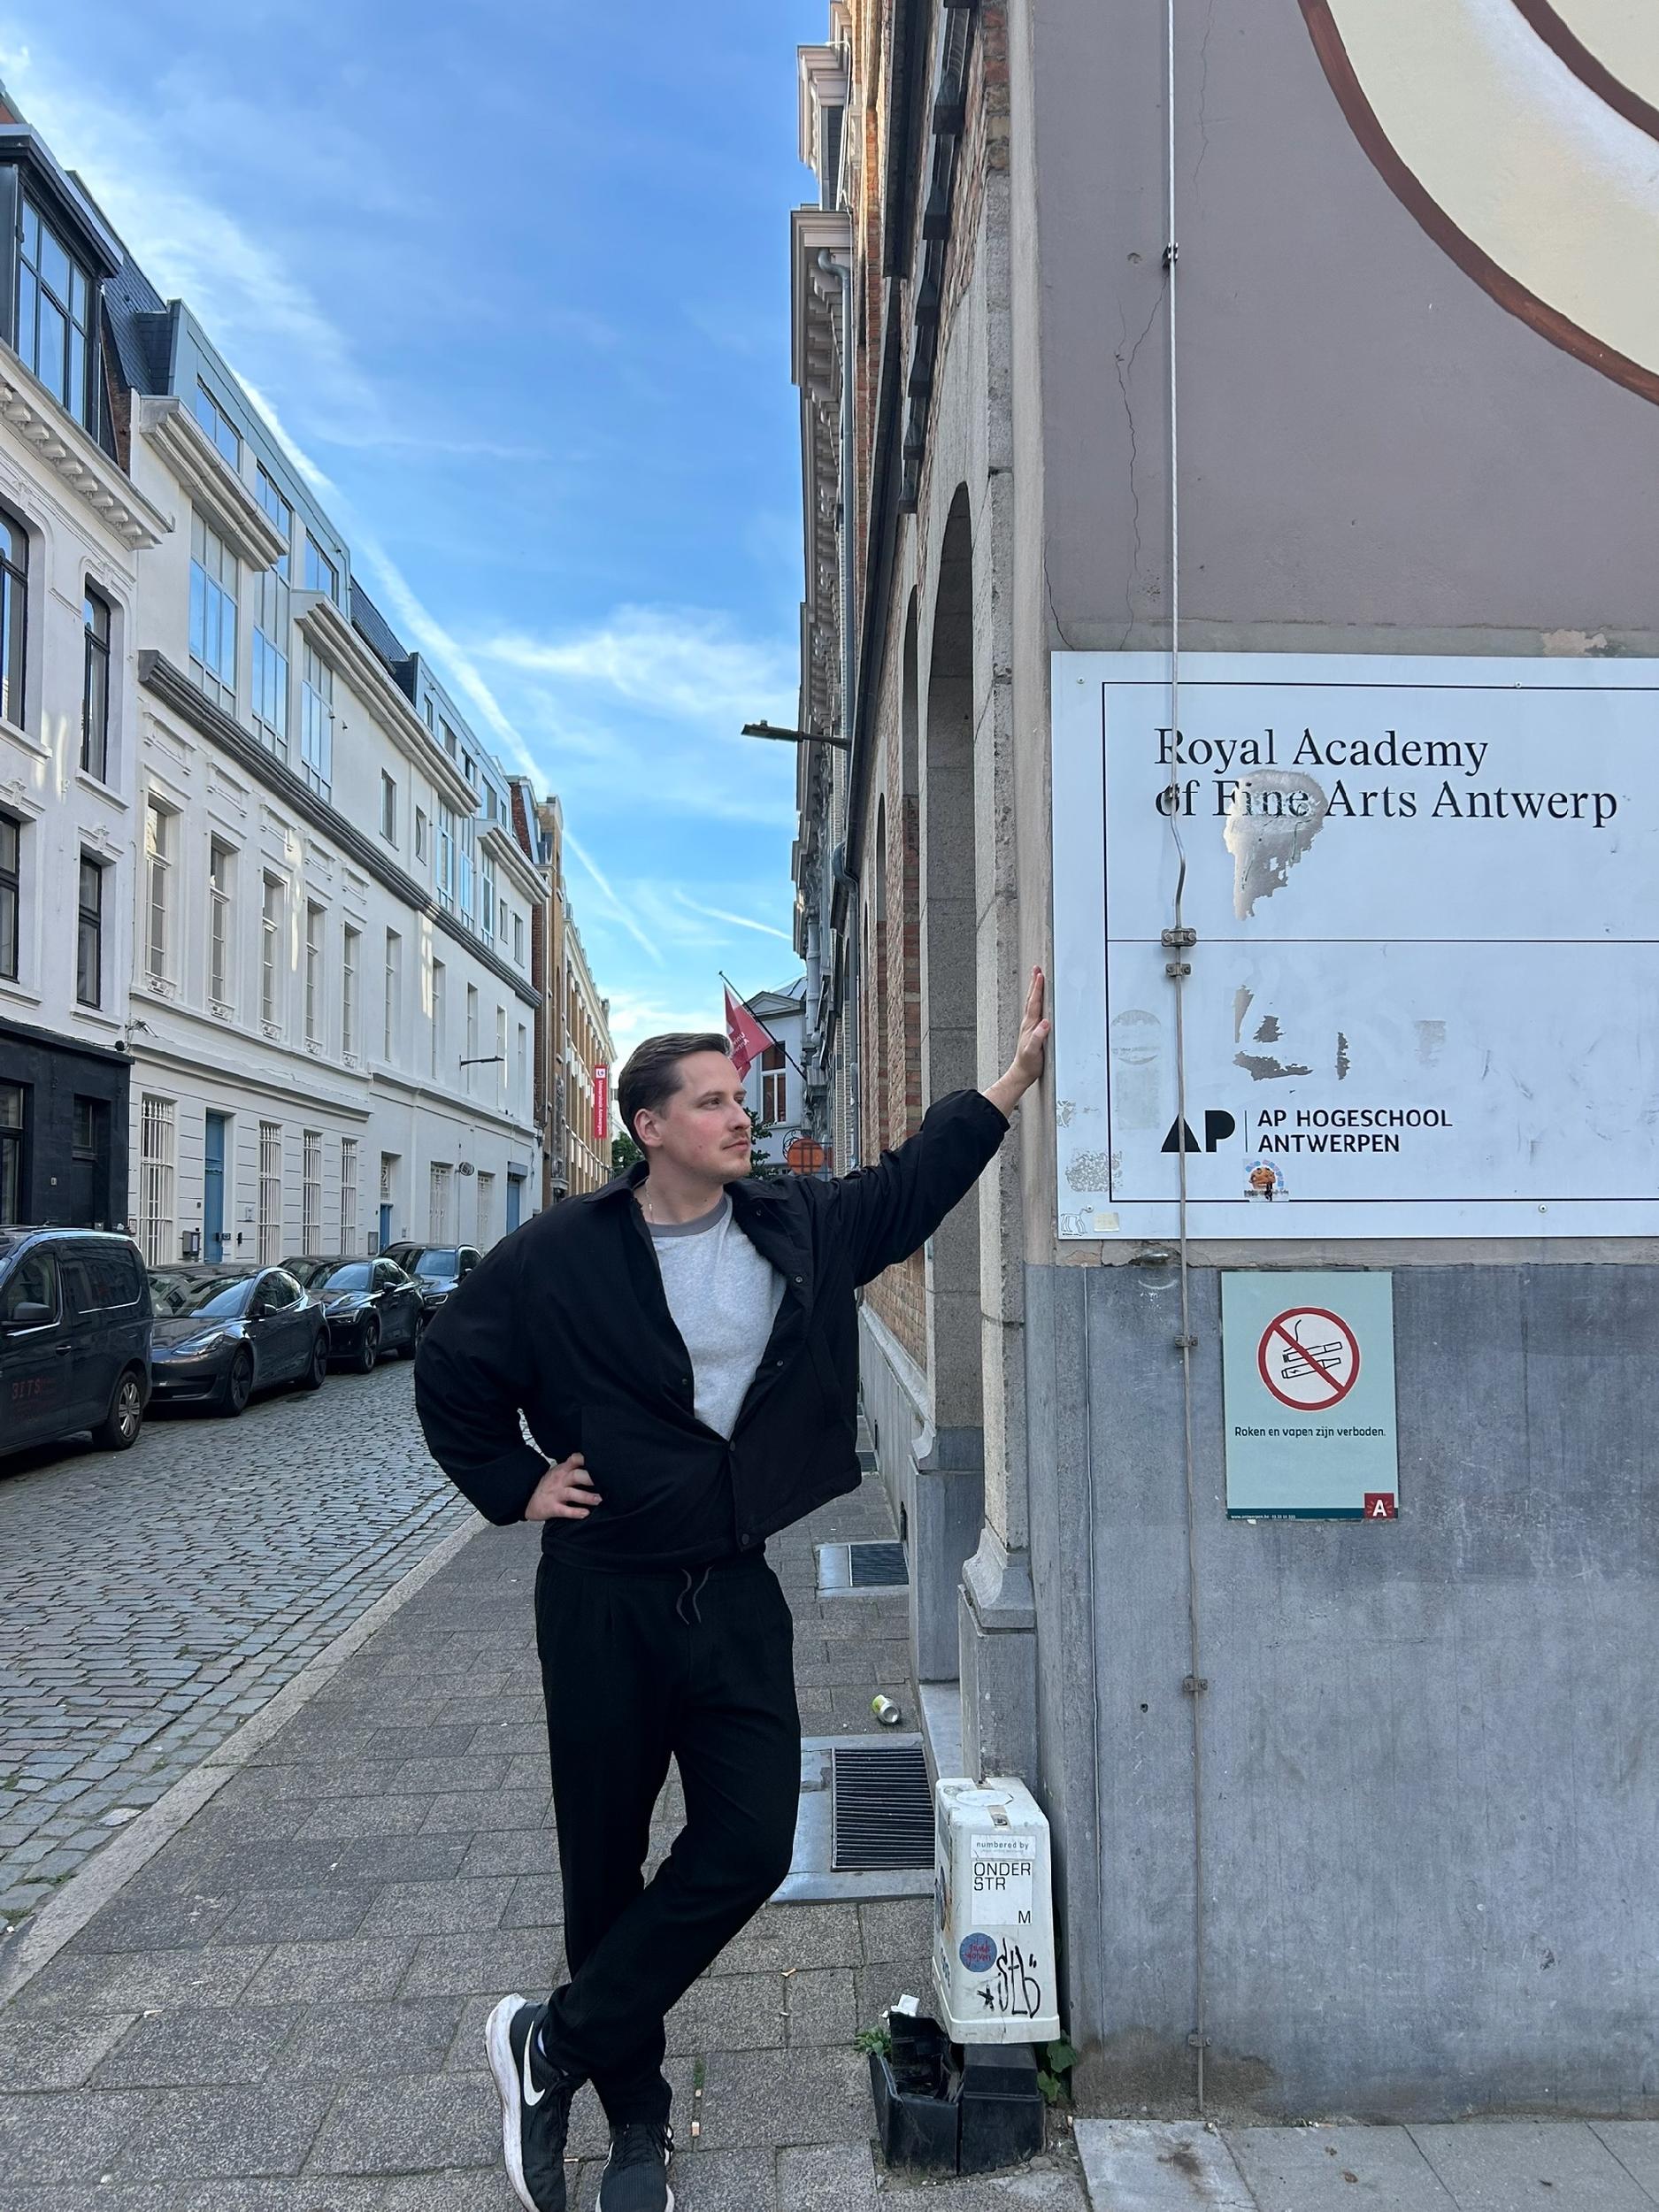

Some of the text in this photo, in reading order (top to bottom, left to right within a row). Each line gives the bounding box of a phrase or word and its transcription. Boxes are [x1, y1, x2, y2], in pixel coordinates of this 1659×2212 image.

[1154, 727, 1489, 777] Royal Academy
[1155, 779, 1617, 828] of Fine Arts Antwerp
[1257, 1109, 1453, 1127] AP HOGESCHOOL
[1160, 1110, 1236, 1153] AP
[1257, 1133, 1400, 1152] ANTWERPEN
[1234, 1426, 1386, 1438] Roken en vapen zijn verboden.
[1372, 1499, 1387, 1517] A
[976, 1840, 1029, 1850] numbered by
[973, 1862, 1031, 1877] ONDER
[973, 1877, 1006, 1891] STR
[1018, 1910, 1031, 1924] M
